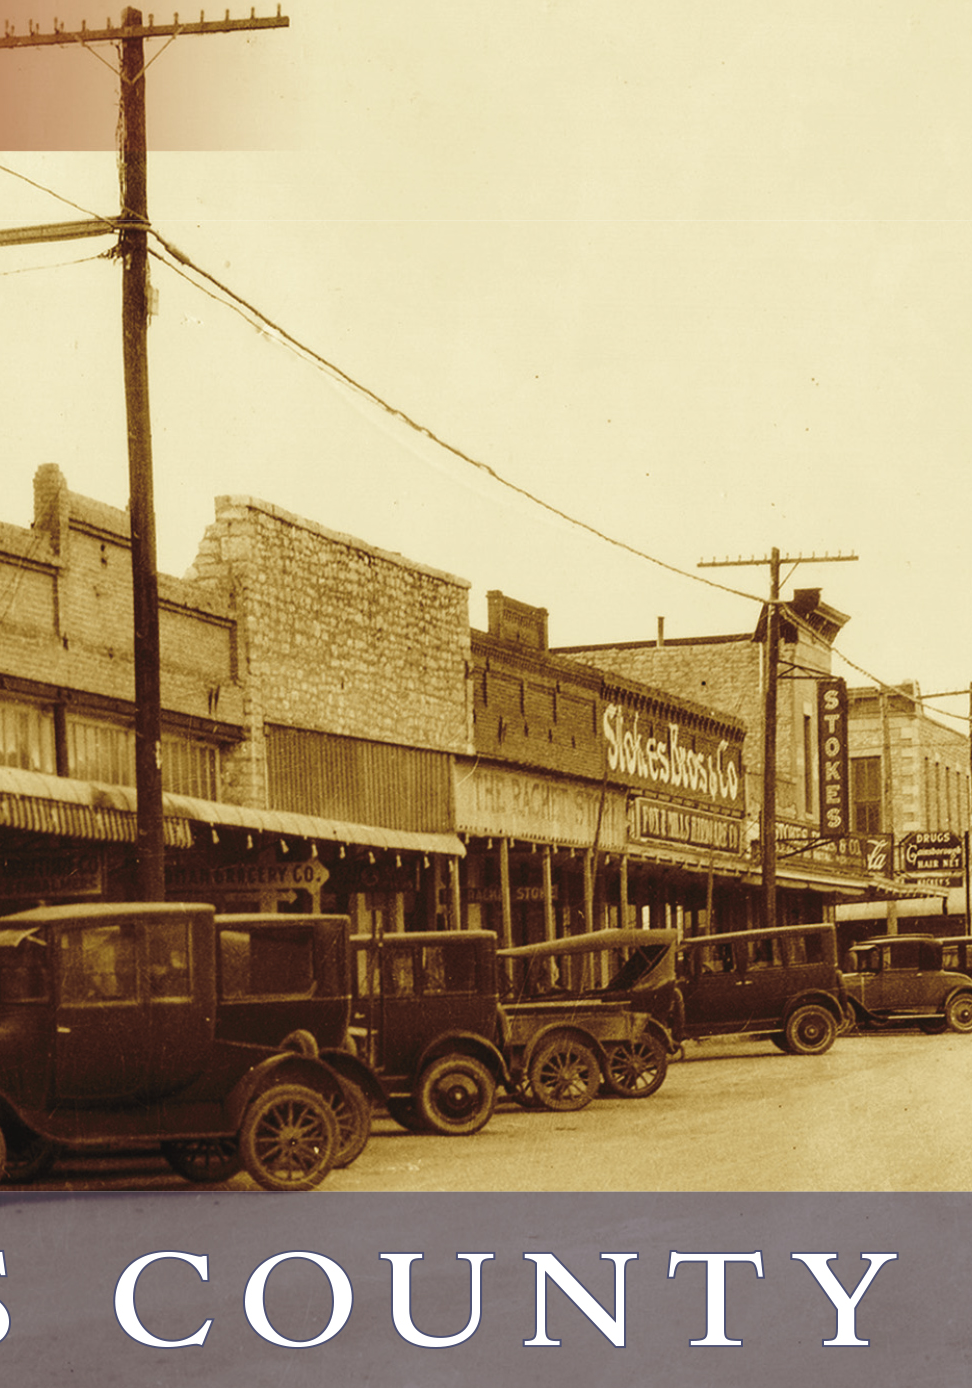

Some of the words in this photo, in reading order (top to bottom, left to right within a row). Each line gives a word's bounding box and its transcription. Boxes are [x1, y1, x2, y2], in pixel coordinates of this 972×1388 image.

[823, 689, 843, 829] STOKES
[916, 833, 950, 844] DRUGS
[292, 864, 322, 884] CO.
